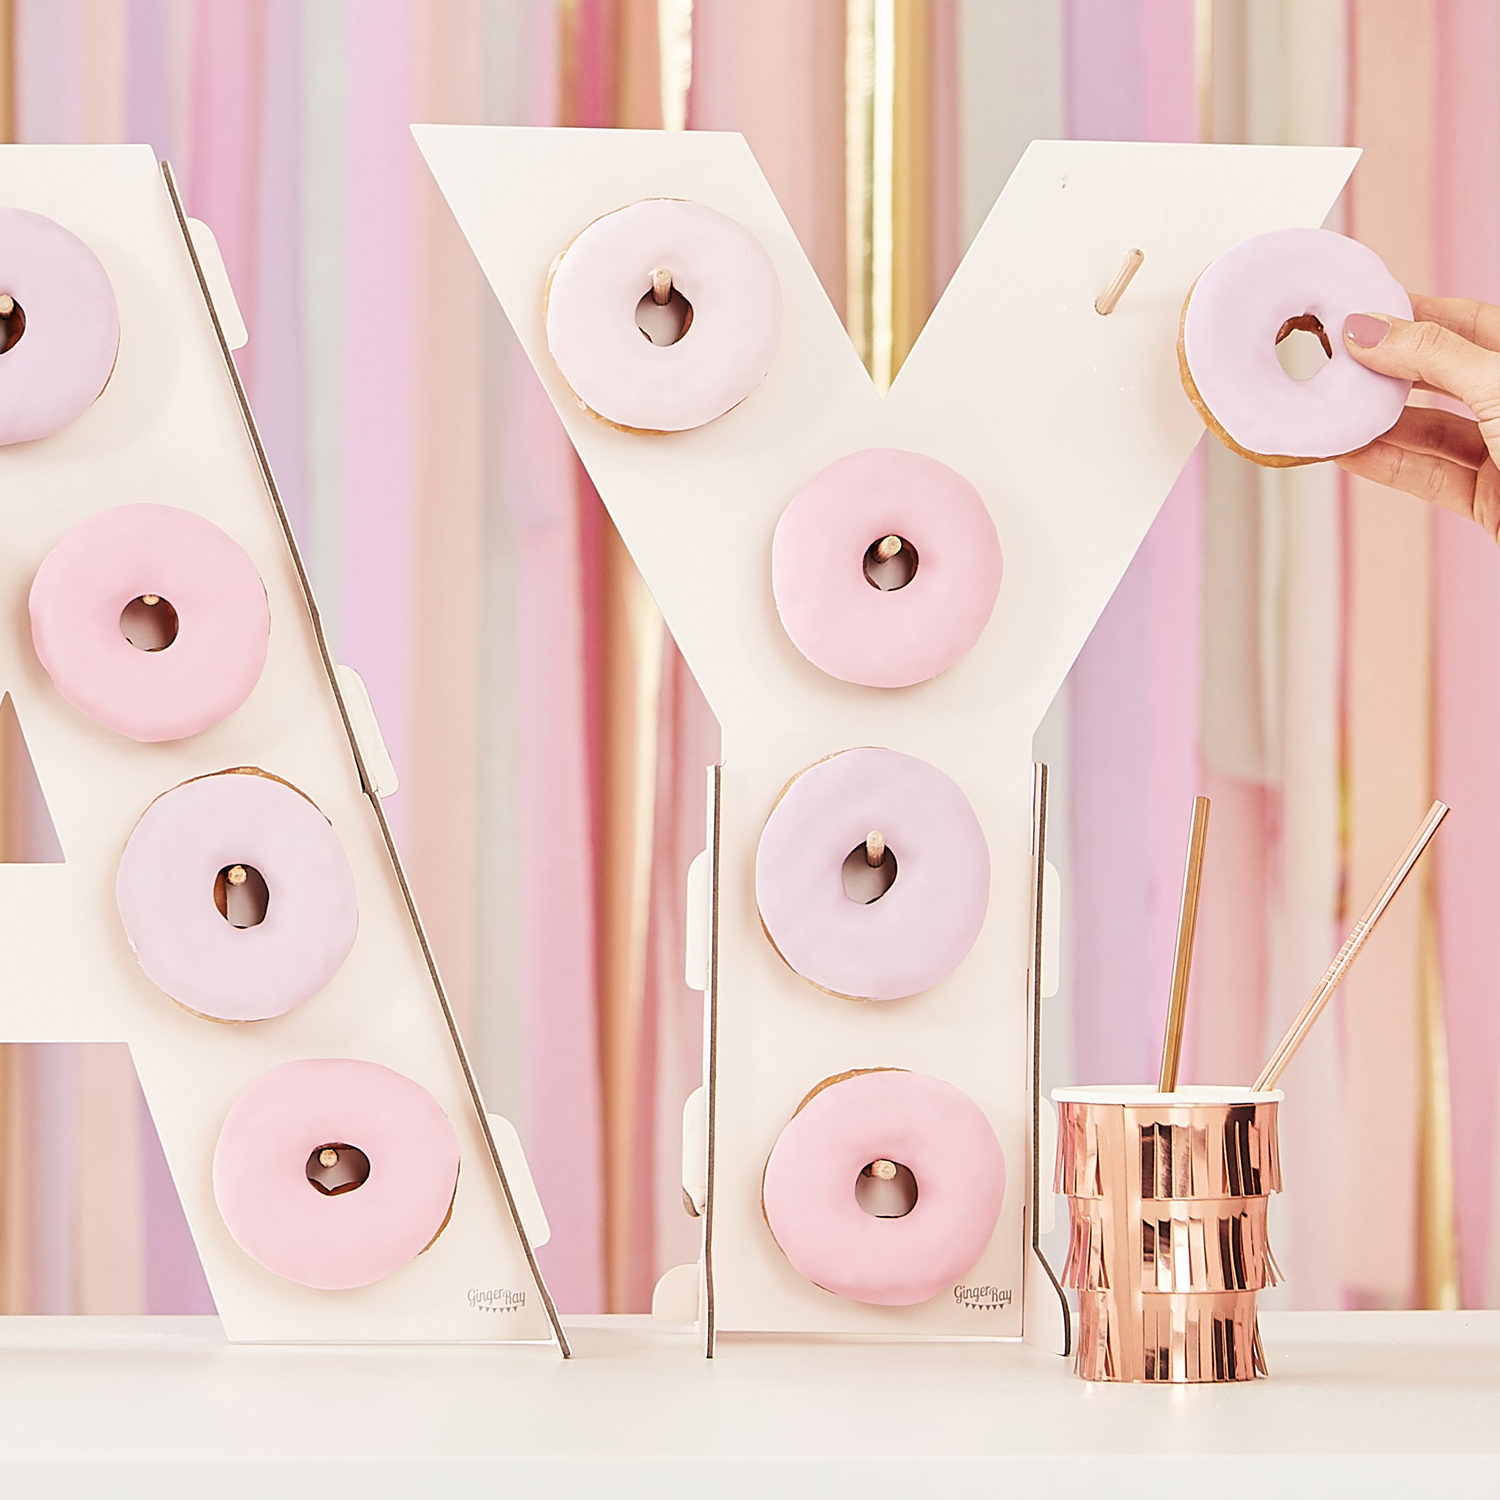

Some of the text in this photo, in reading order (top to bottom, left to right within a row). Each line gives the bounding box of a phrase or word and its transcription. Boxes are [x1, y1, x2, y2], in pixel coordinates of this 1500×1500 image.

[467, 1288, 526, 1307] Ginger Ray
[953, 1284, 1012, 1304] Ginger Ray
